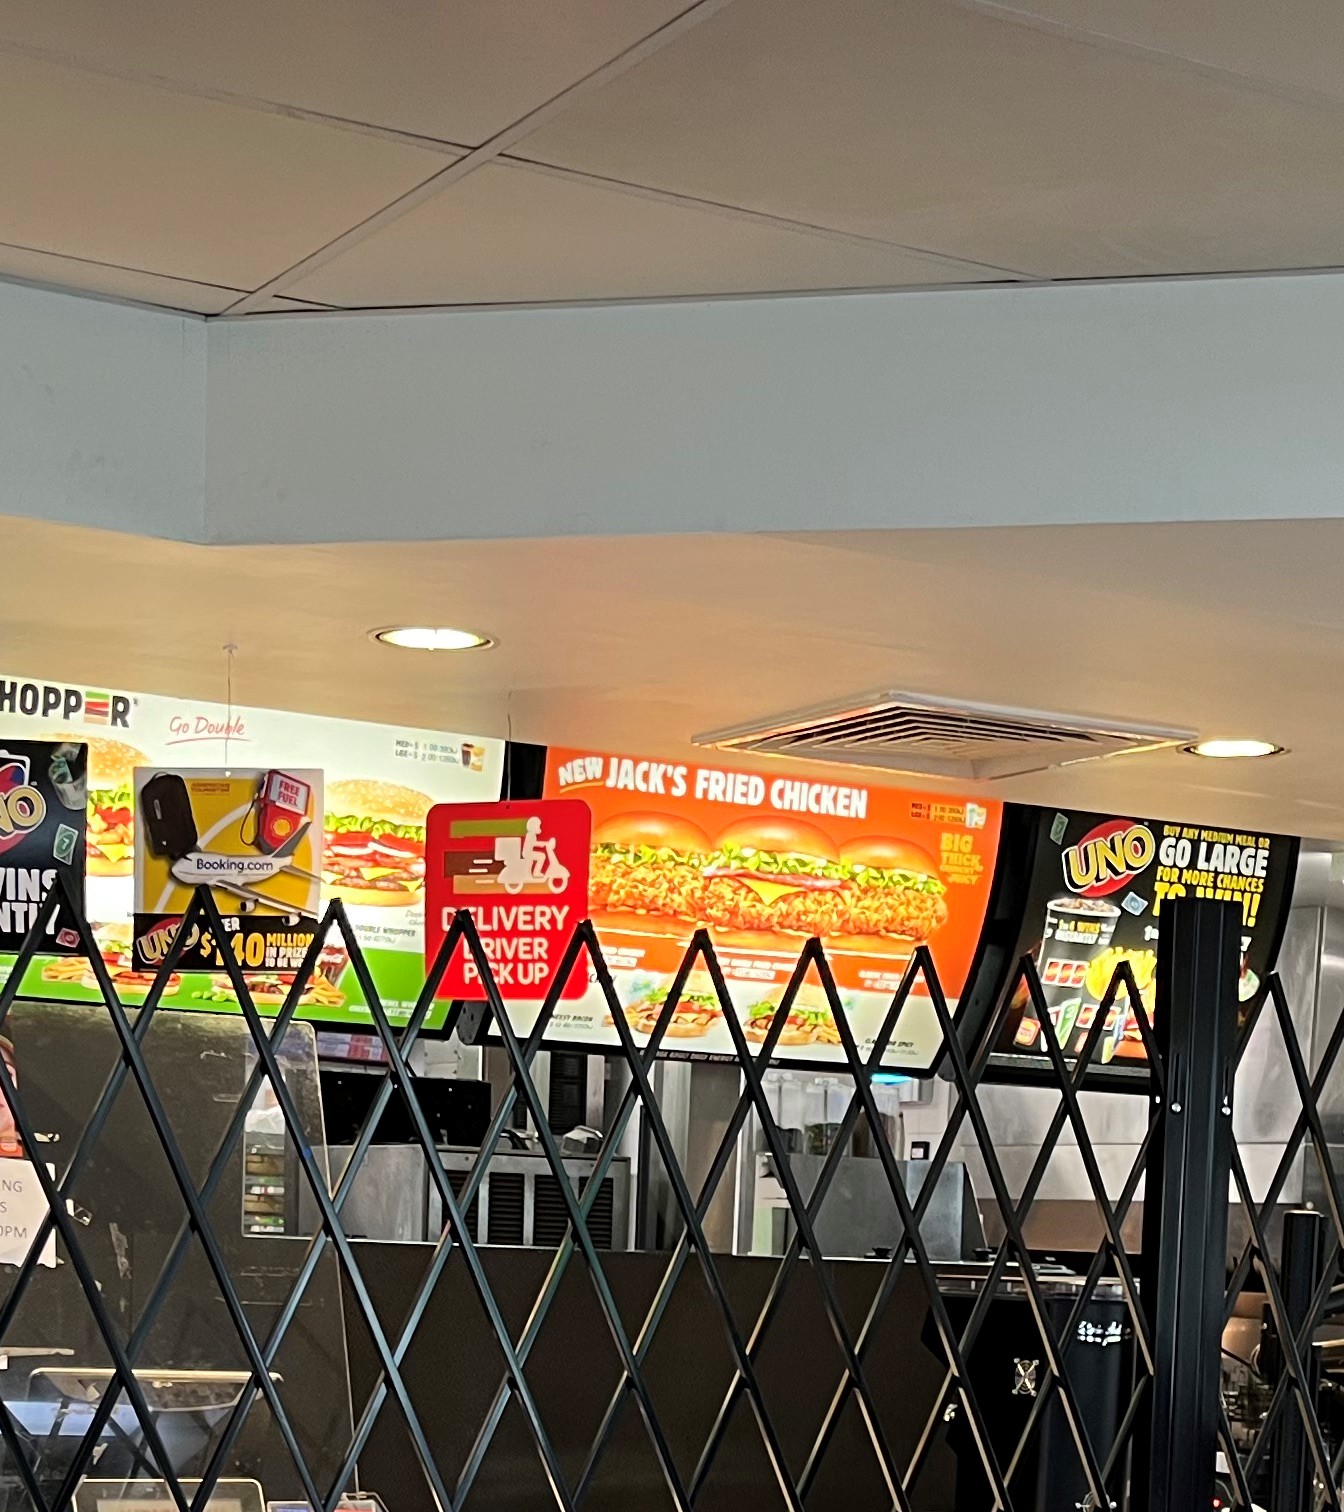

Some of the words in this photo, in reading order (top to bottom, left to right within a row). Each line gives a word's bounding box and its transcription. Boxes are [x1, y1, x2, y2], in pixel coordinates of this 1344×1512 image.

[169, 715, 190, 736] Go
[195, 716, 246, 736] Double
[279, 779, 300, 796] FREE
[558, 756, 604, 787] NEW
[605, 757, 688, 797] JACK'S
[695, 768, 766, 807] FRIED
[770, 779, 868, 820] CHICKEN
[278, 792, 300, 807] FUEL
[941, 832, 974, 854] BIG
[1163, 825, 1181, 837] BUY
[1182, 827, 1199, 840] ANY
[196, 858, 274, 873] Booking.com
[1067, 826, 1155, 887] UNO
[1159, 837, 1192, 868] GO
[1197, 841, 1270, 878] LARGE
[1156, 866, 1180, 883] FOR
[1181, 868, 1215, 887] MORE
[1216, 874, 1265, 893] CHANCES
[517, 963, 550, 985] UP
